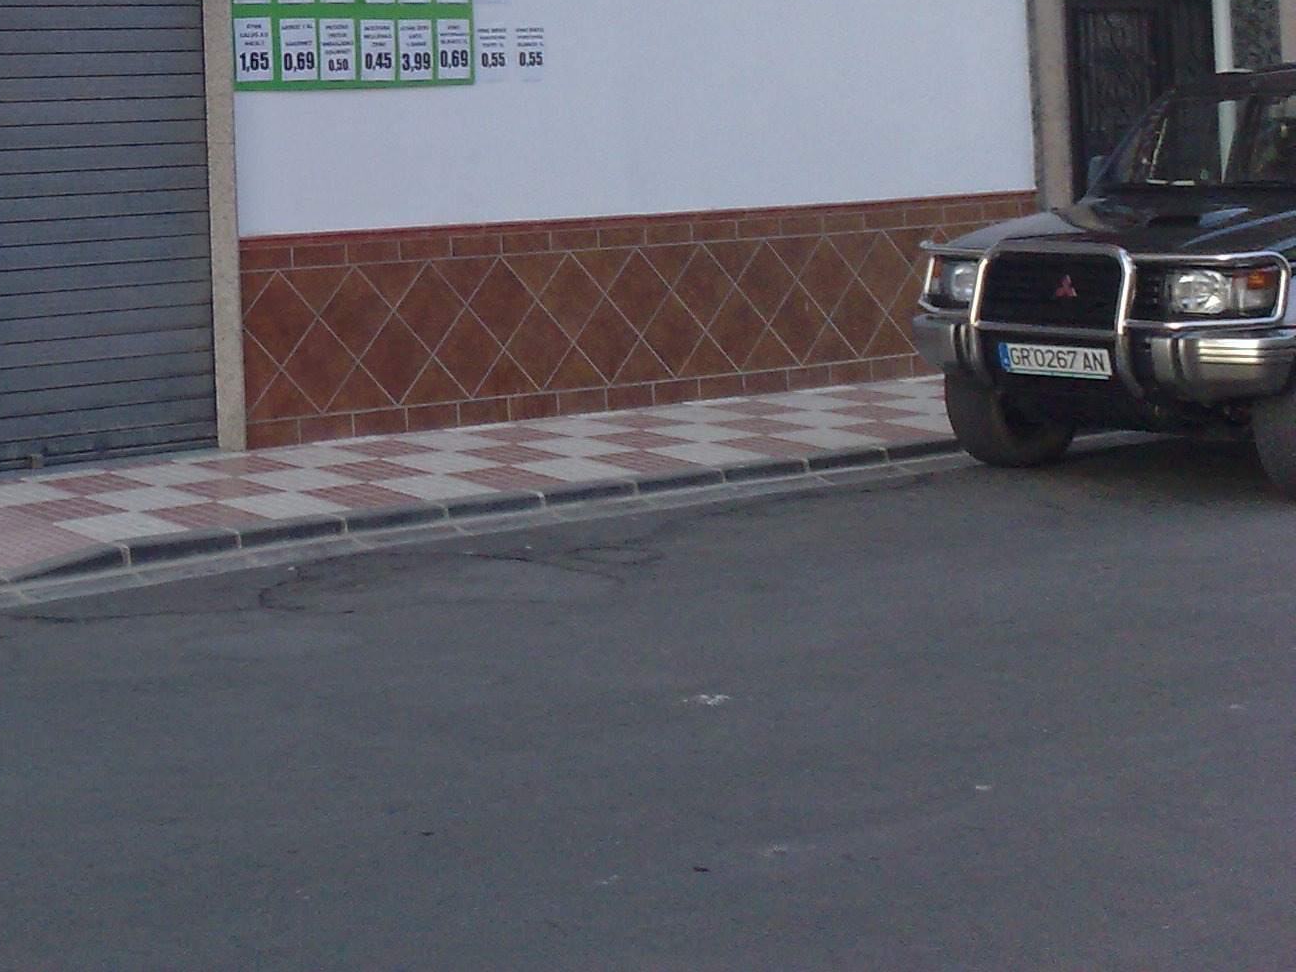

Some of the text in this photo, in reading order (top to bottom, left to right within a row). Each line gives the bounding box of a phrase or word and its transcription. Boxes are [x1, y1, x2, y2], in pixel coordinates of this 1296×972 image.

[239, 52, 269, 72] 1,65
[284, 51, 314, 72] 0,69
[365, 52, 392, 69] 0,45
[402, 52, 431, 72] 3,99
[440, 50, 468, 68] 0,69
[1034, 348, 1077, 369] 0267
[1083, 351, 1105, 372] AN
